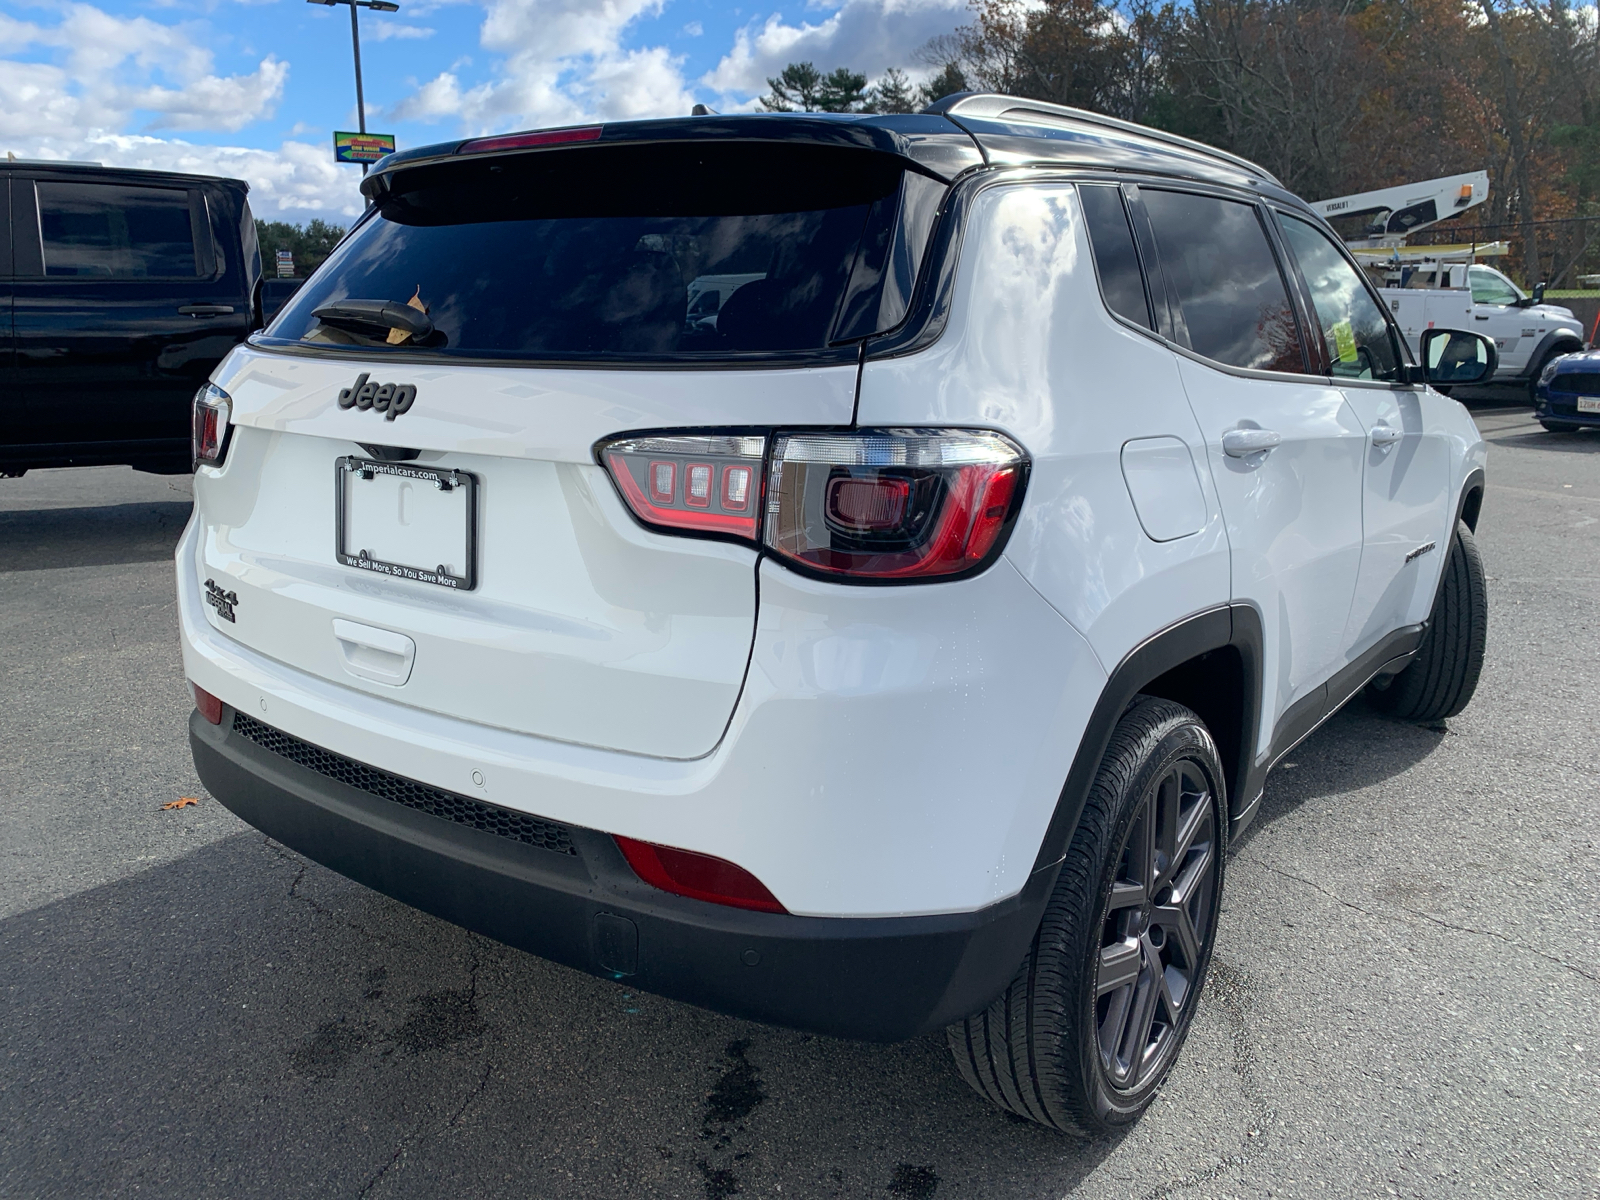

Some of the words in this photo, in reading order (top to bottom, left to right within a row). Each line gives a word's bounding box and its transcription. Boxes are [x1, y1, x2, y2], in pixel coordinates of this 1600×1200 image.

[338, 372, 417, 421] Jeep
[361, 462, 438, 480] Imperialcars.com
[346, 556, 357, 567] We
[358, 560, 371, 570] Sell
[372, 562, 392, 575] More,
[393, 566, 402, 575] So
[403, 567, 417, 579] You
[418, 571, 436, 583] Save
[437, 575, 457, 588] More
